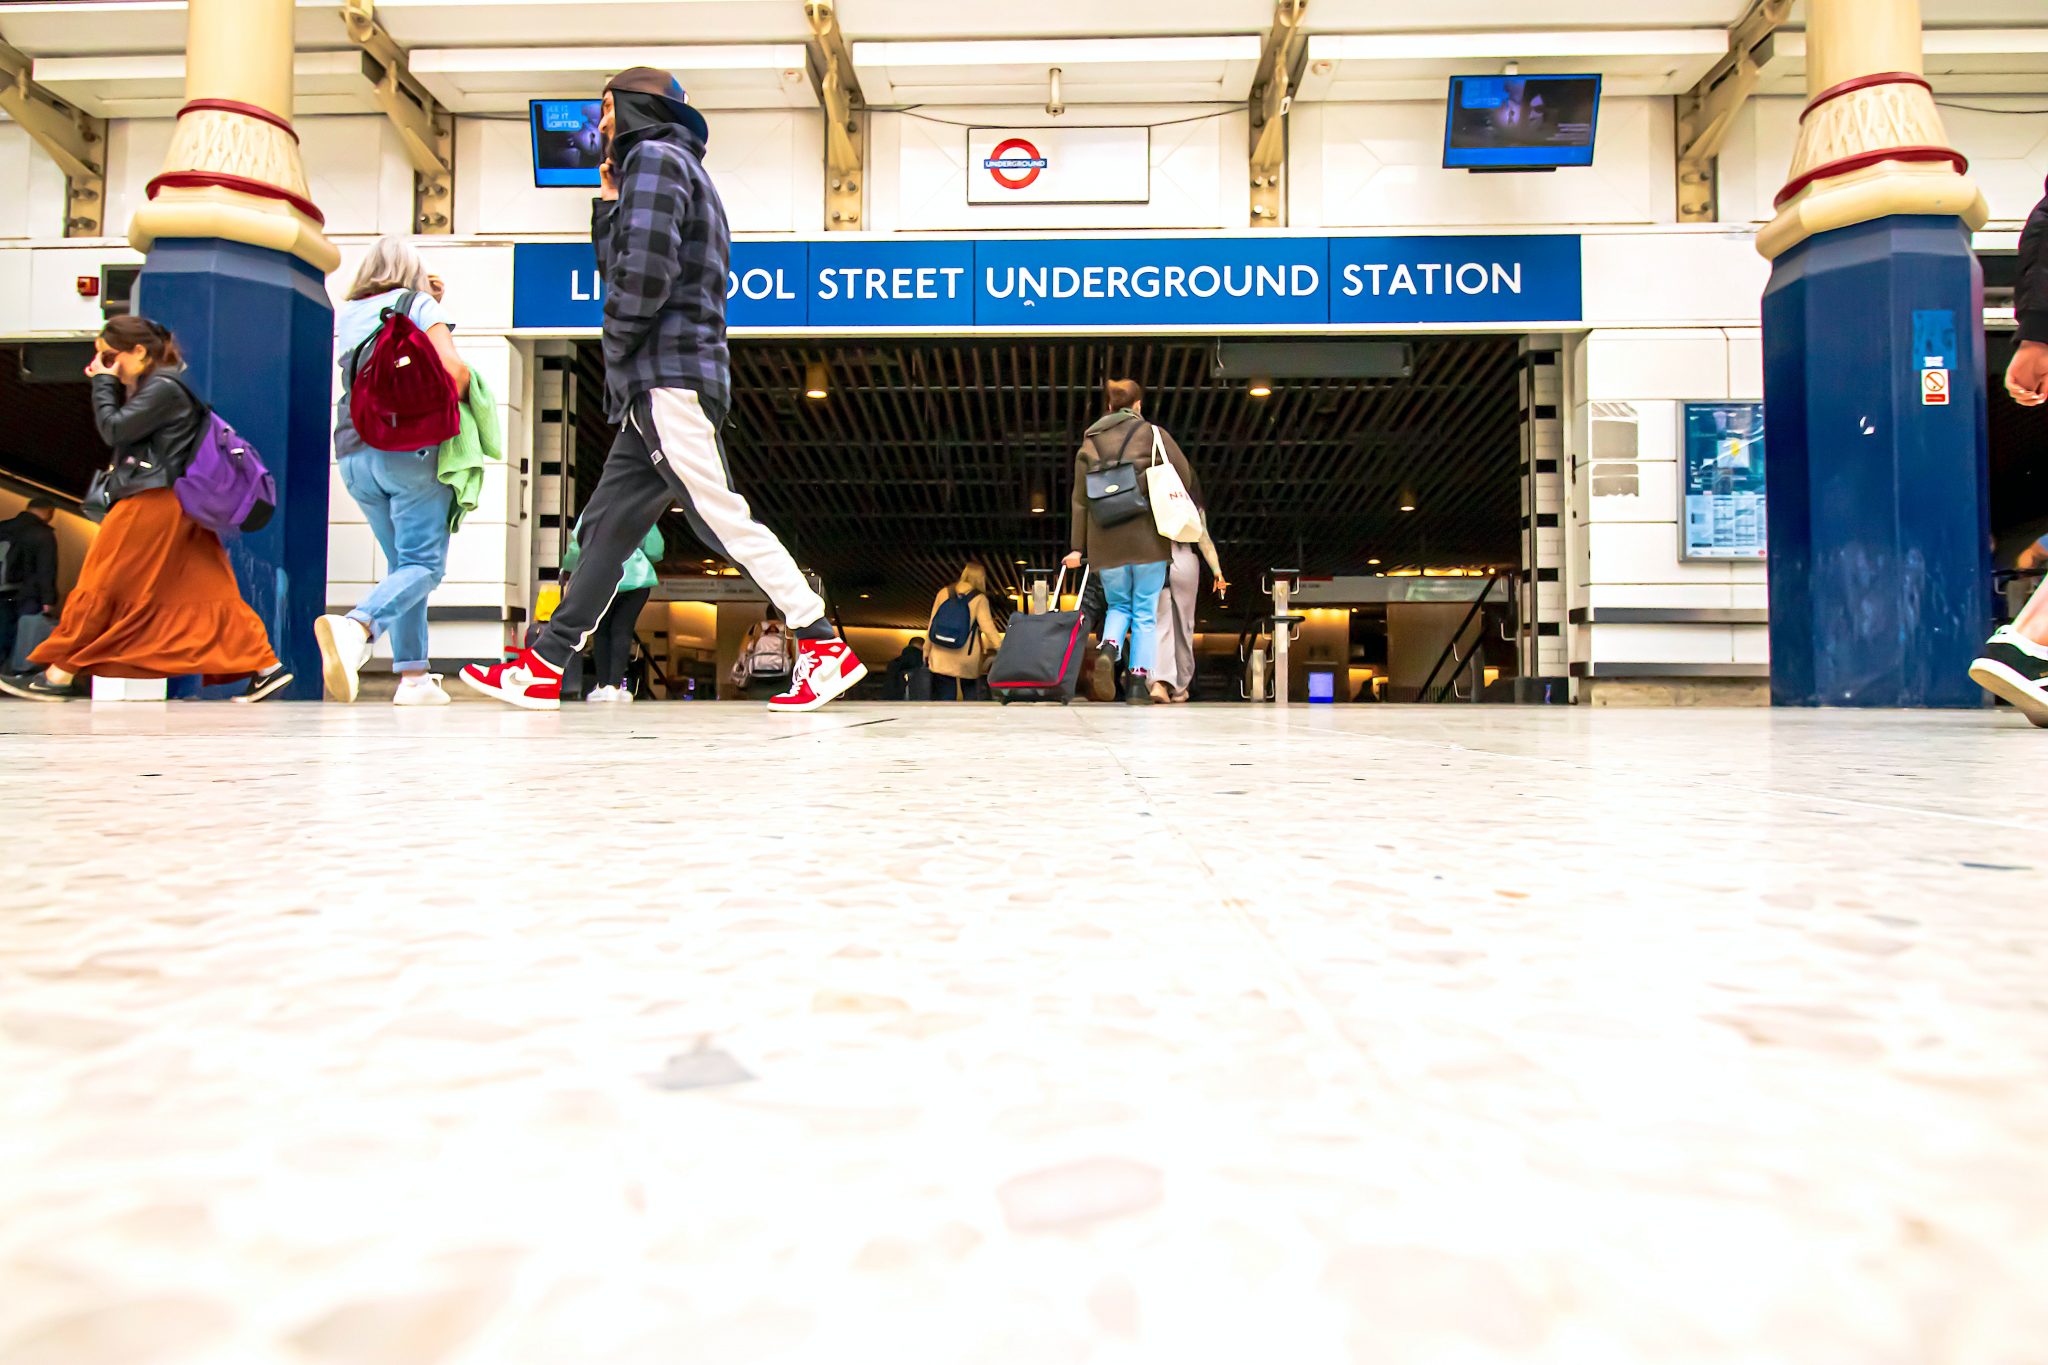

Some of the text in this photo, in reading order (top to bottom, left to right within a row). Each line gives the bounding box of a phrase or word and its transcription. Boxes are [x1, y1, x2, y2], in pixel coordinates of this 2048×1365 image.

[985, 160, 1045, 168] UNDERGROUND
[818, 267, 964, 300] STREET
[986, 264, 1319, 299] UNDERGROUND
[1342, 262, 1521, 297] STATION
